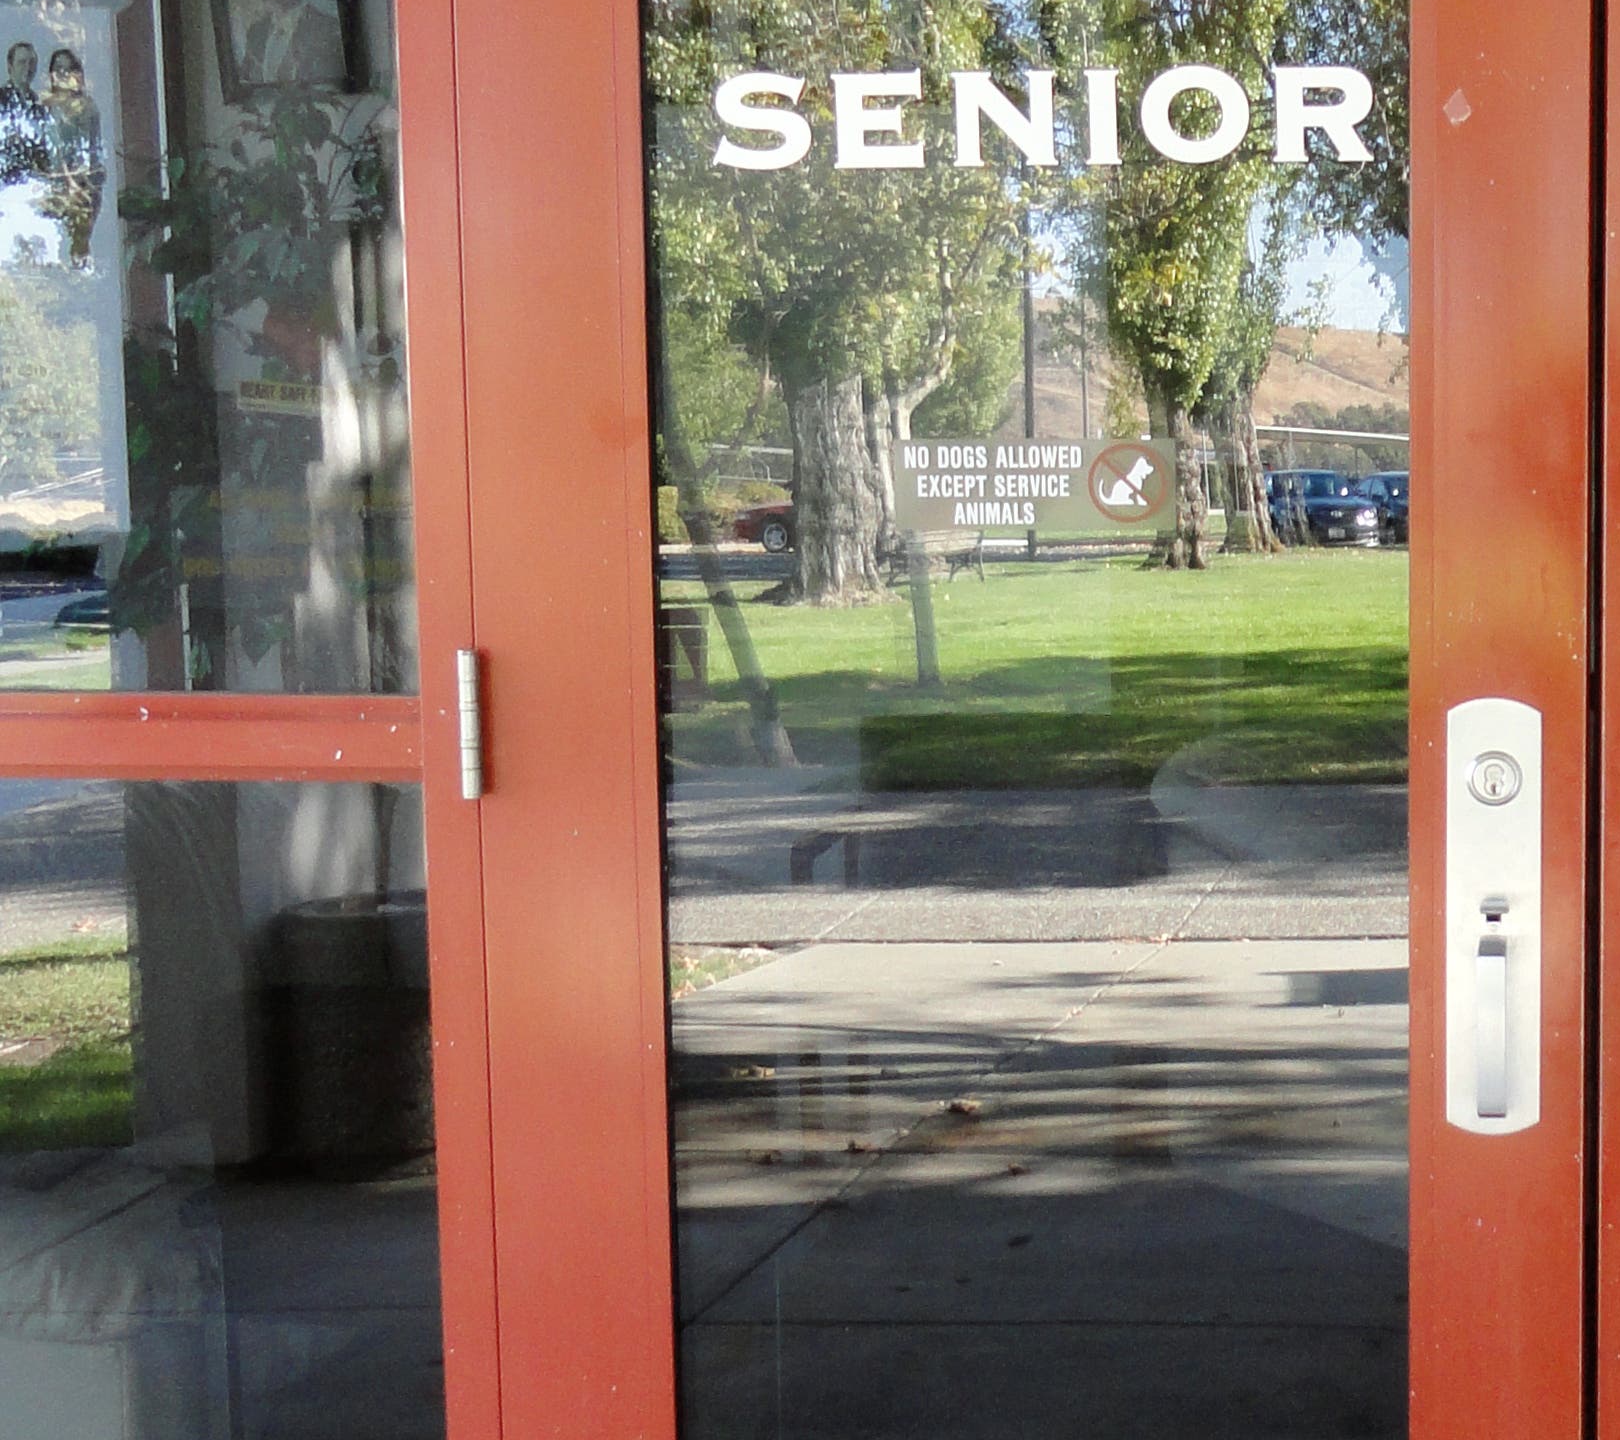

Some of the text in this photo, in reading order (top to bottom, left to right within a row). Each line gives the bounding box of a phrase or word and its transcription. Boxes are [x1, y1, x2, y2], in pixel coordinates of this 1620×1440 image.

[712, 64, 1376, 170] SENIOR
[903, 446, 1082, 469] NO DOGS ALLOWED
[917, 474, 1070, 498] EXCEPT SERVICE
[954, 502, 1035, 525] ANIMALS
